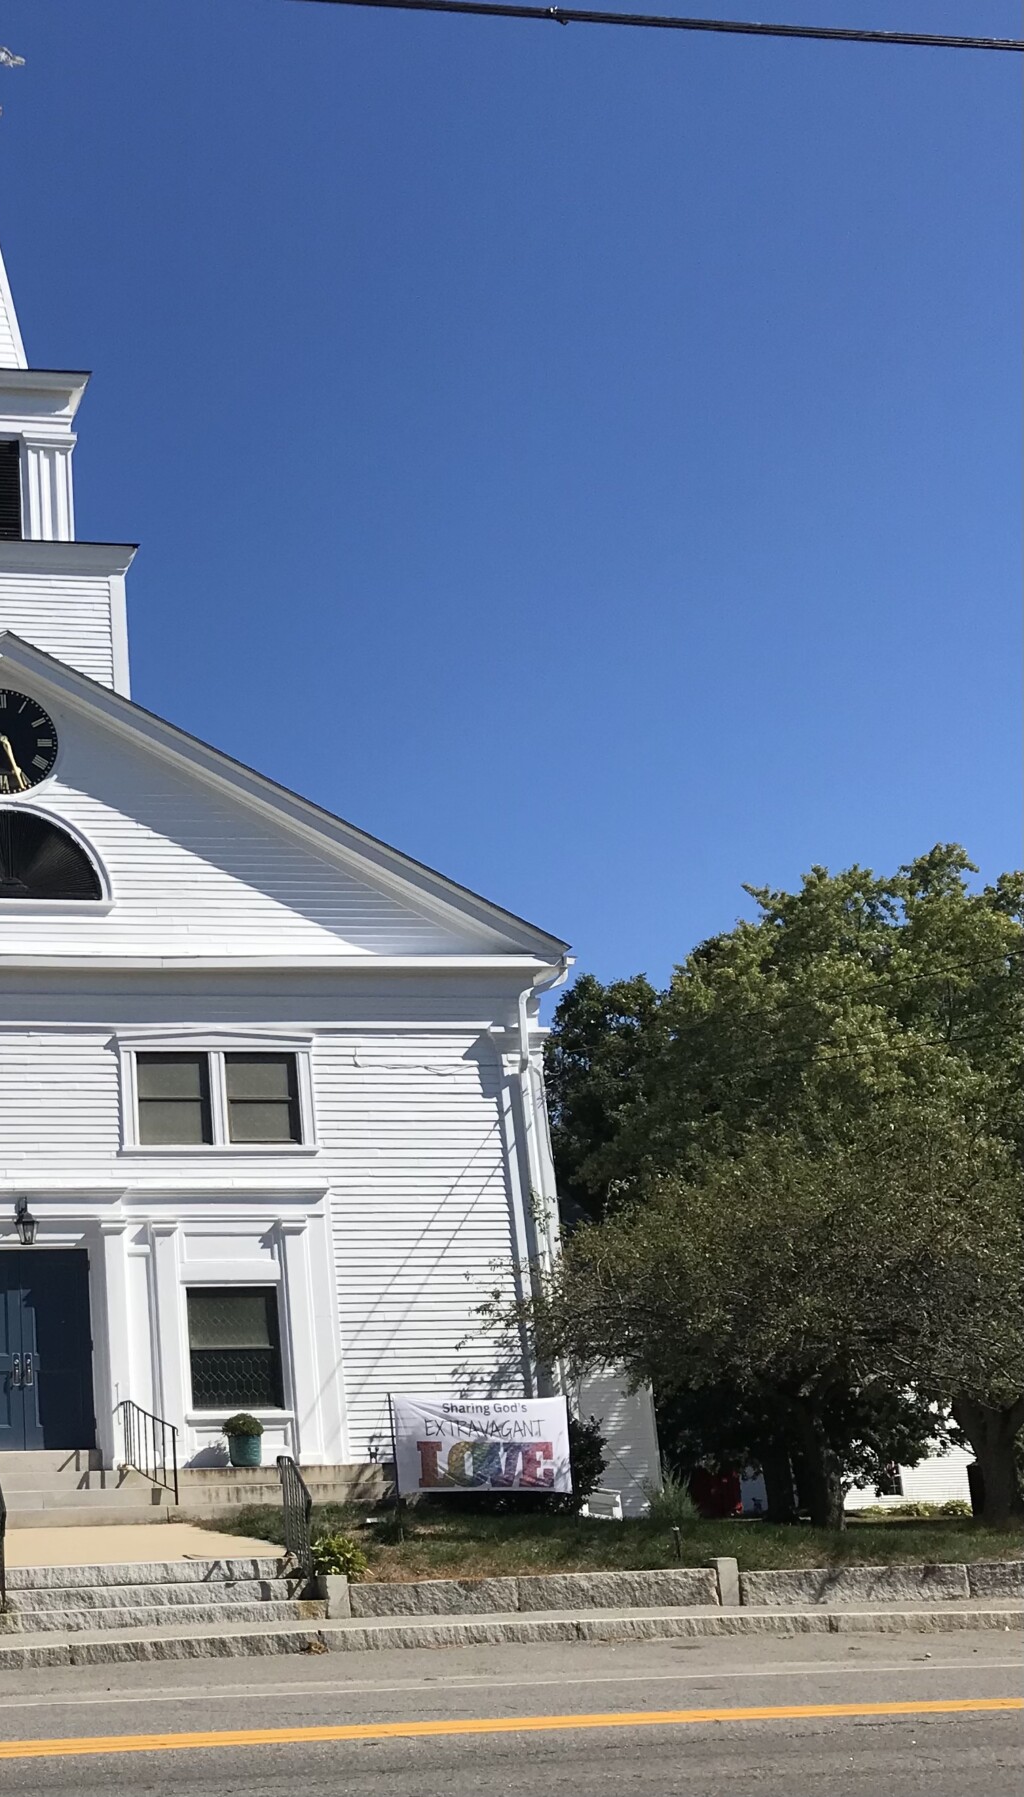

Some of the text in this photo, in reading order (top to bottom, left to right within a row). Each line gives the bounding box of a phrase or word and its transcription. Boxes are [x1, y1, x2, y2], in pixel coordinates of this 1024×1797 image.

[31, 717, 46, 728] II
[37, 738, 53, 747] III
[442, 1402, 528, 1416] Sharing God's
[425, 1418, 546, 1438] EXTRAVAGANT
[416, 1440, 555, 1488] LOVE
